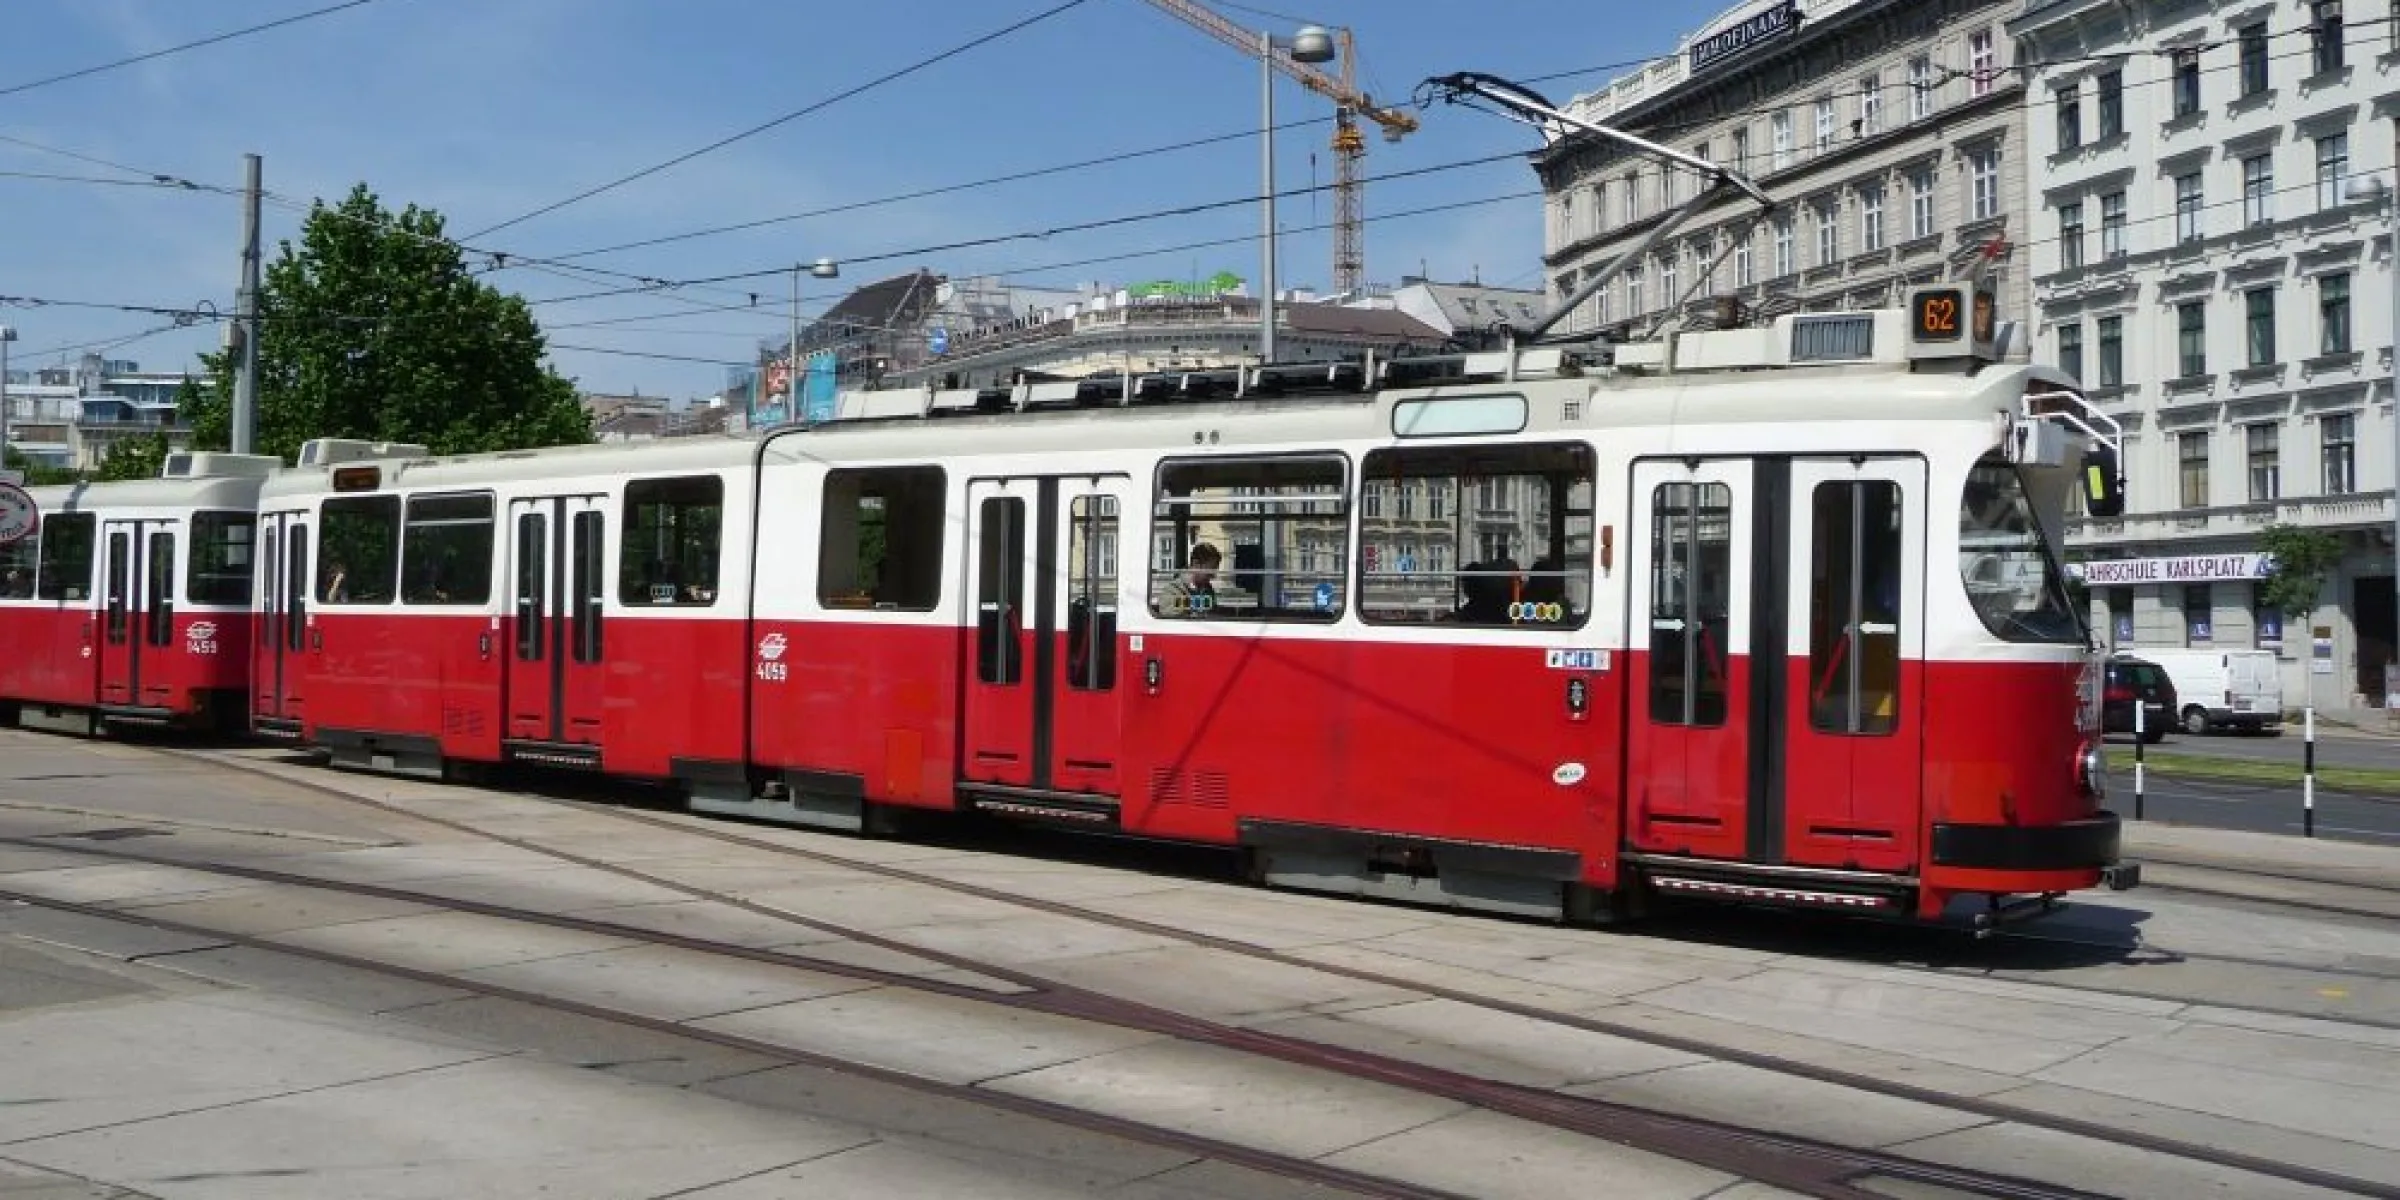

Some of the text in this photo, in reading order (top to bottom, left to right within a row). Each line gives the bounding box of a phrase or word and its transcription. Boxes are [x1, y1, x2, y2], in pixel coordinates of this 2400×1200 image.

[1691, 5, 1788, 64] IMMOFINANZ
[1924, 298, 1956, 331] 62
[2084, 556, 2245, 582] FAHRSCHULE KARLSPLATZ
[186, 640, 217, 654] 1459
[756, 661, 787, 681] 4059
